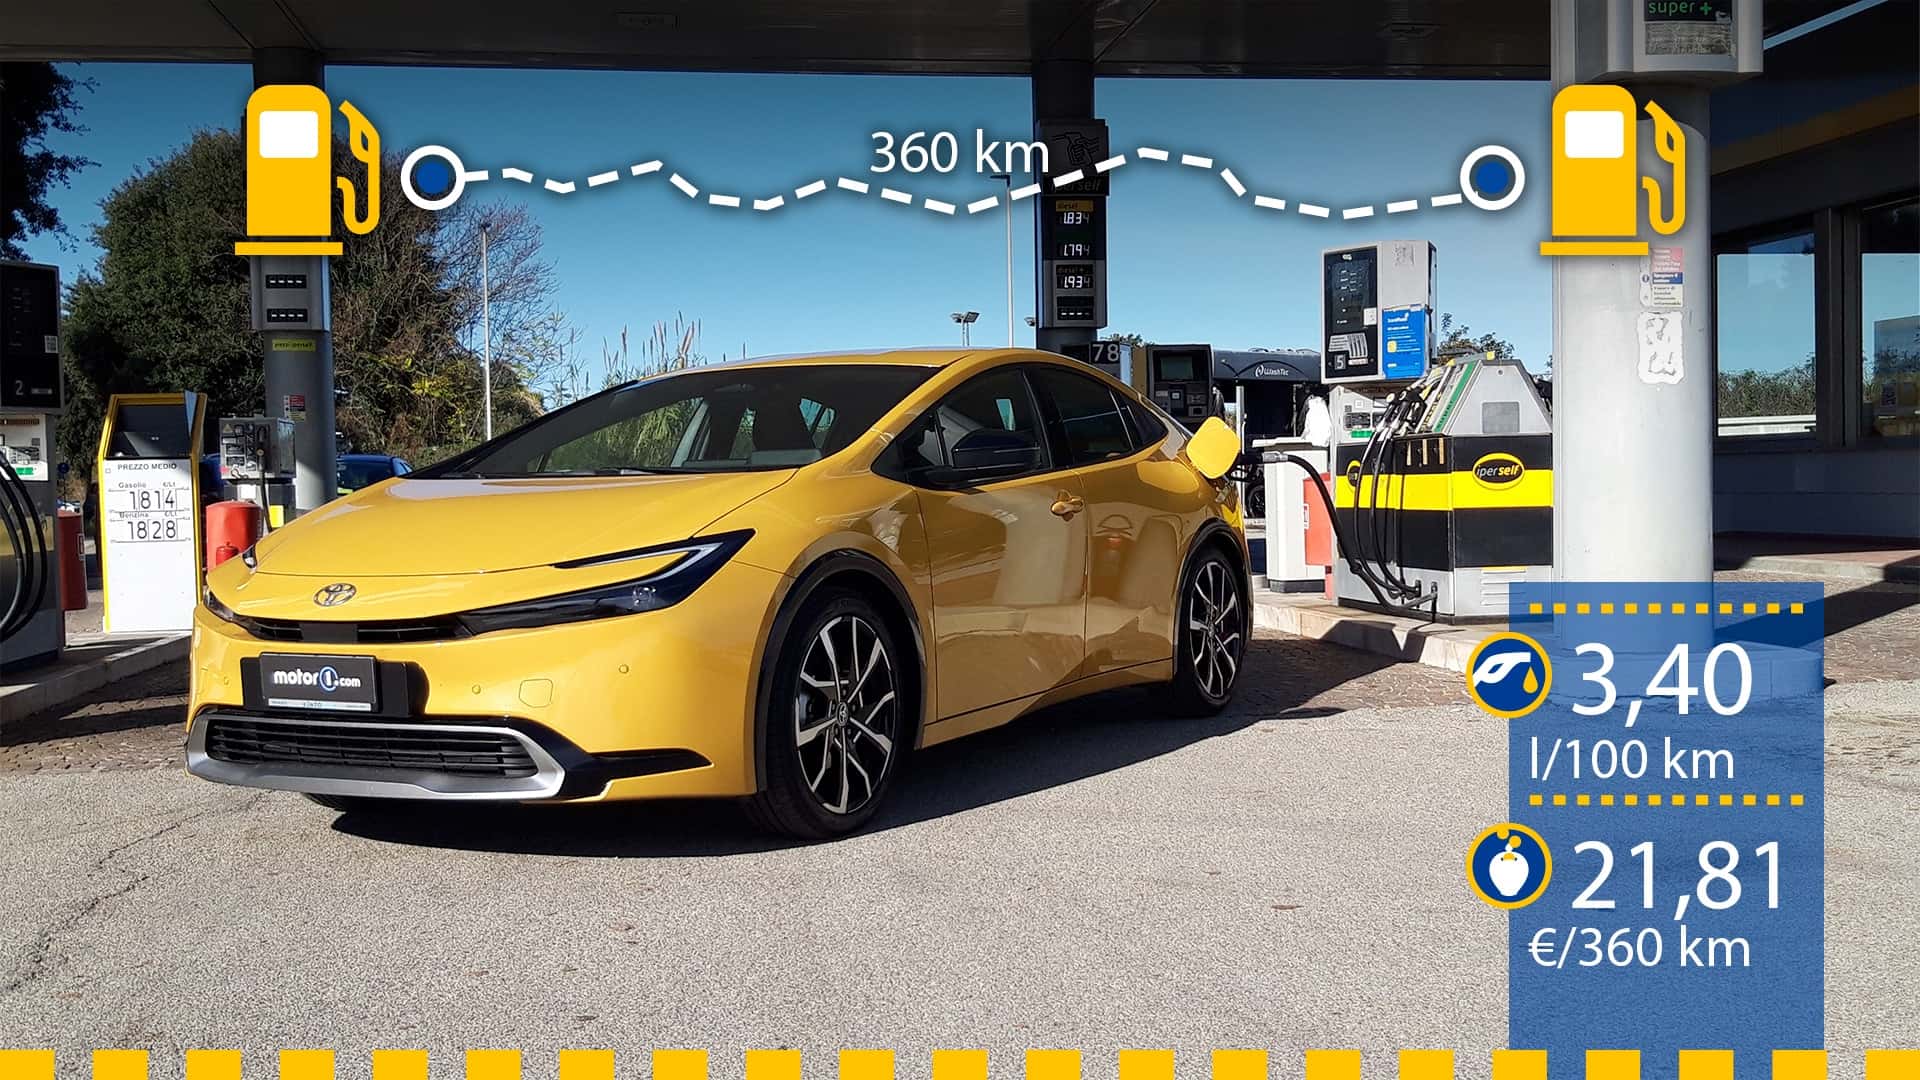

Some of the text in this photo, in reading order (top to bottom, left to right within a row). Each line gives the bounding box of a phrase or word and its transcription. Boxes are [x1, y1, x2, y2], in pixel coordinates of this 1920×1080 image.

[1648, 1, 1695, 17] super
[1092, 344, 1119, 362] 78
[1335, 355, 1345, 369] 5
[15, 380, 24, 396] 2
[129, 490, 175, 510] 1814
[127, 520, 176, 540] 1828
